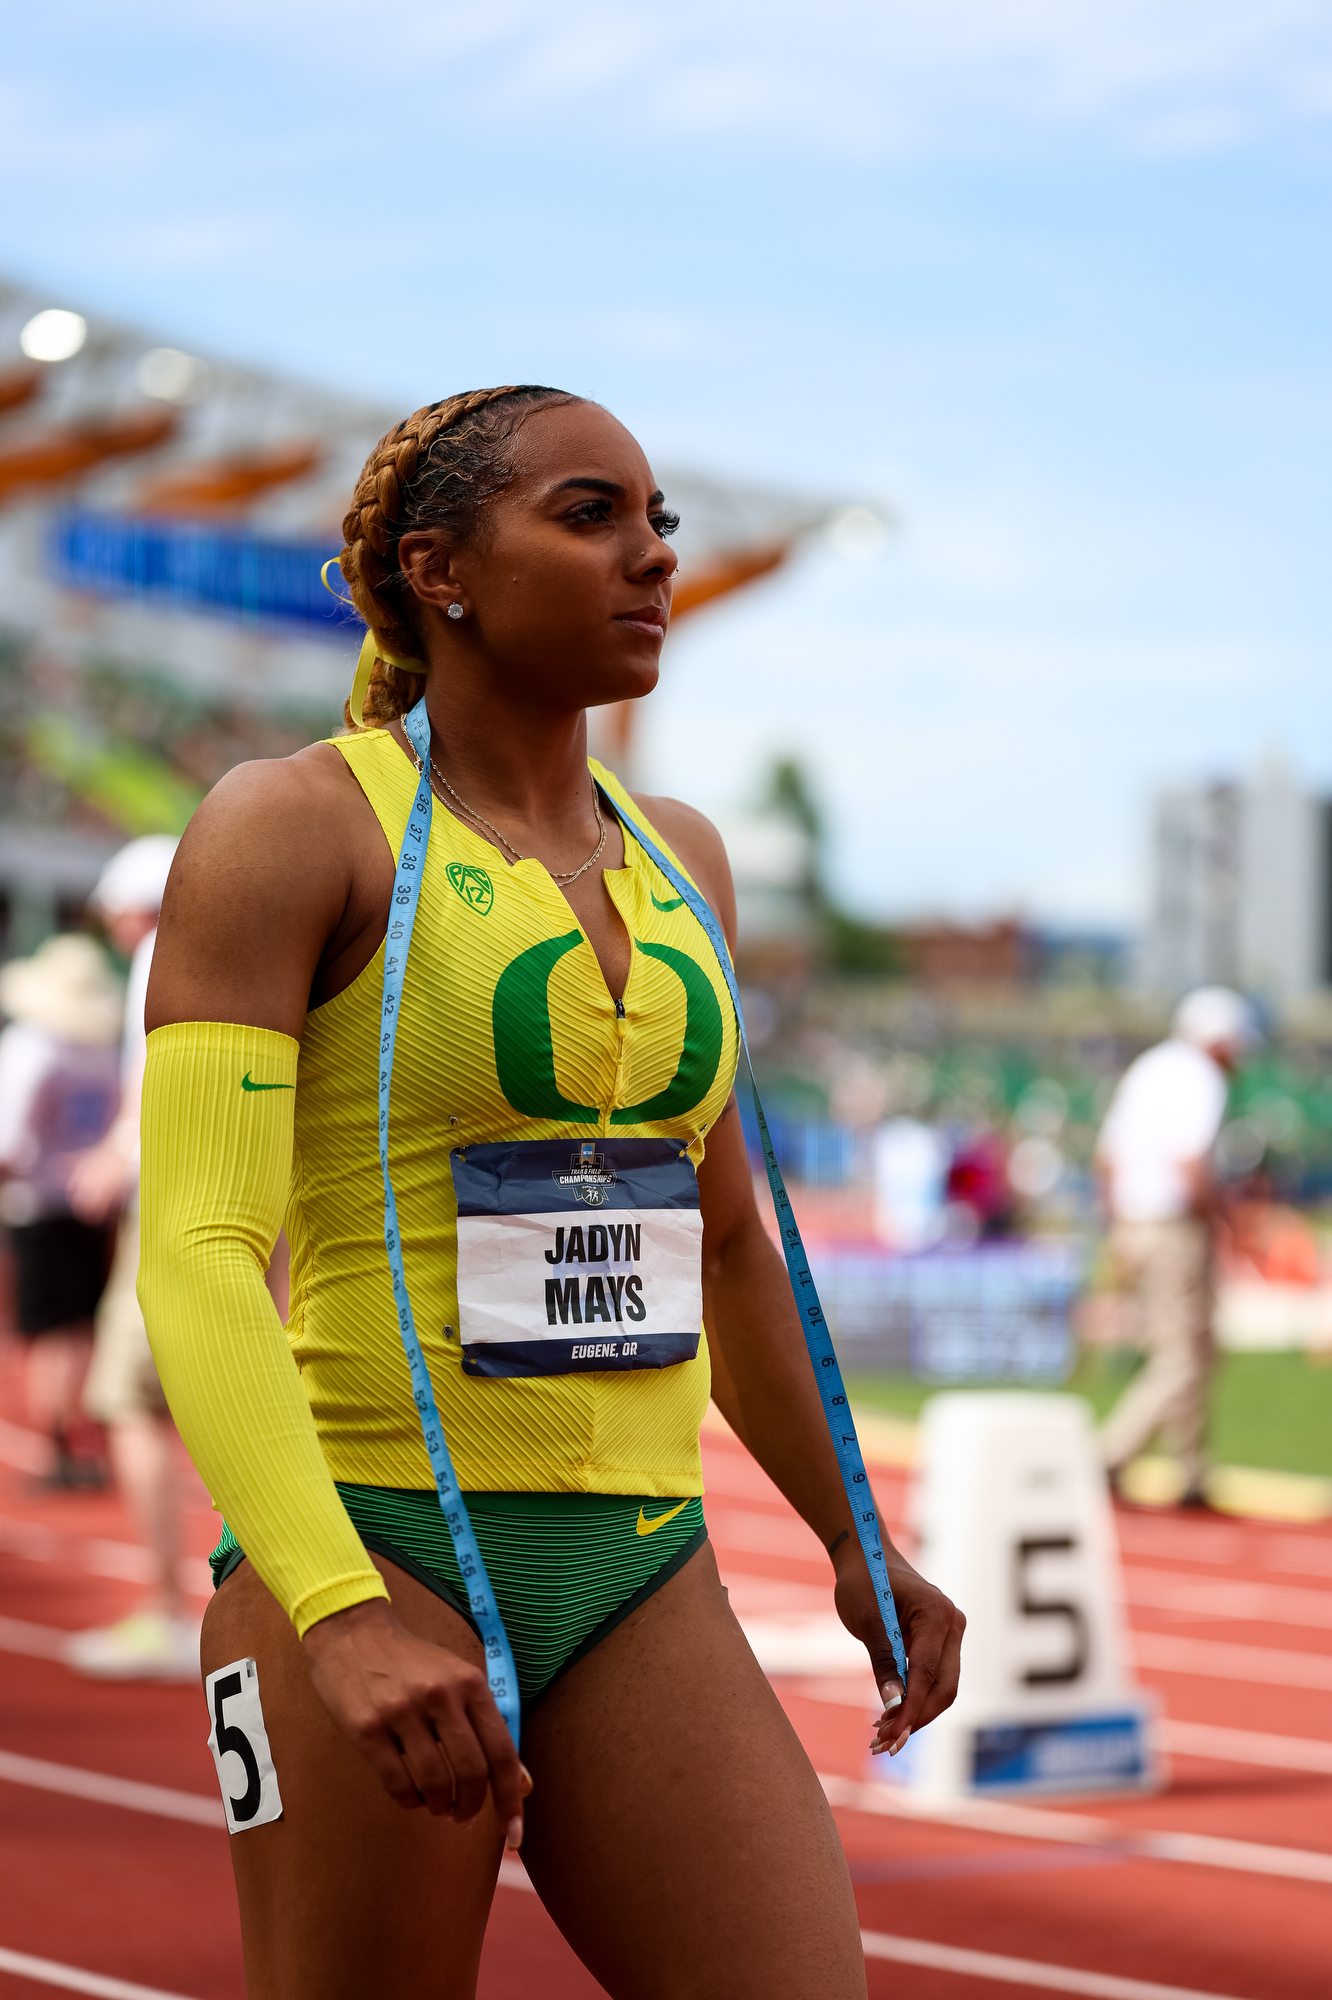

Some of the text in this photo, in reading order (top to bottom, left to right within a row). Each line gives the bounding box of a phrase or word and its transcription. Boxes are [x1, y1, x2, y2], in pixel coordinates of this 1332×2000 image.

[416, 793, 430, 815] 36
[408, 823, 423, 843] 37
[401, 853, 418, 871] 38
[449, 865, 491, 893] PAC
[395, 885, 412, 905] 39
[465, 885, 489, 904] 12
[389, 920, 406, 940] 40
[385, 956, 400, 976] 41
[383, 994, 396, 1017] 42
[492, 929, 723, 1125] O
[381, 1032, 391, 1054] 43
[380, 1071, 388, 1093] 44
[767, 1150, 779, 1172] 14
[560, 1174, 613, 1184] CHAMPONSHIPS
[777, 1189, 789, 1211] 13
[386, 1229, 396, 1251] 48
[545, 1224, 641, 1265] JADYN
[786, 1227, 801, 1250] 12
[392, 1268, 401, 1291] 49
[797, 1269, 812, 1288] 11
[545, 1275, 646, 1325] MAYS
[399, 1308, 410, 1332] 50
[807, 1306, 823, 1327] 10
[406, 1348, 419, 1371] 51
[572, 1342, 637, 1359] EUGENE, OR
[821, 1357, 835, 1368] 9
[414, 1389, 429, 1414] 52
[832, 1395, 846, 1406] 8
[425, 1430, 440, 1455] 53
[841, 1435, 856, 1446] 7
[435, 1471, 451, 1495] 54
[852, 1472, 866, 1484] 6
[446, 1511, 464, 1537] 55
[862, 1511, 875, 1523] 5
[459, 1553, 477, 1579] 56
[872, 1551, 883, 1561] 4
[883, 1589, 893, 1601] 3
[471, 1595, 489, 1618] 57
[1016, 1535, 1089, 1686] 5
[893, 1628, 902, 1640] 2
[485, 1635, 503, 1660] 58
[491, 1676, 507, 1699] 59
[214, 1671, 261, 1822] 5
